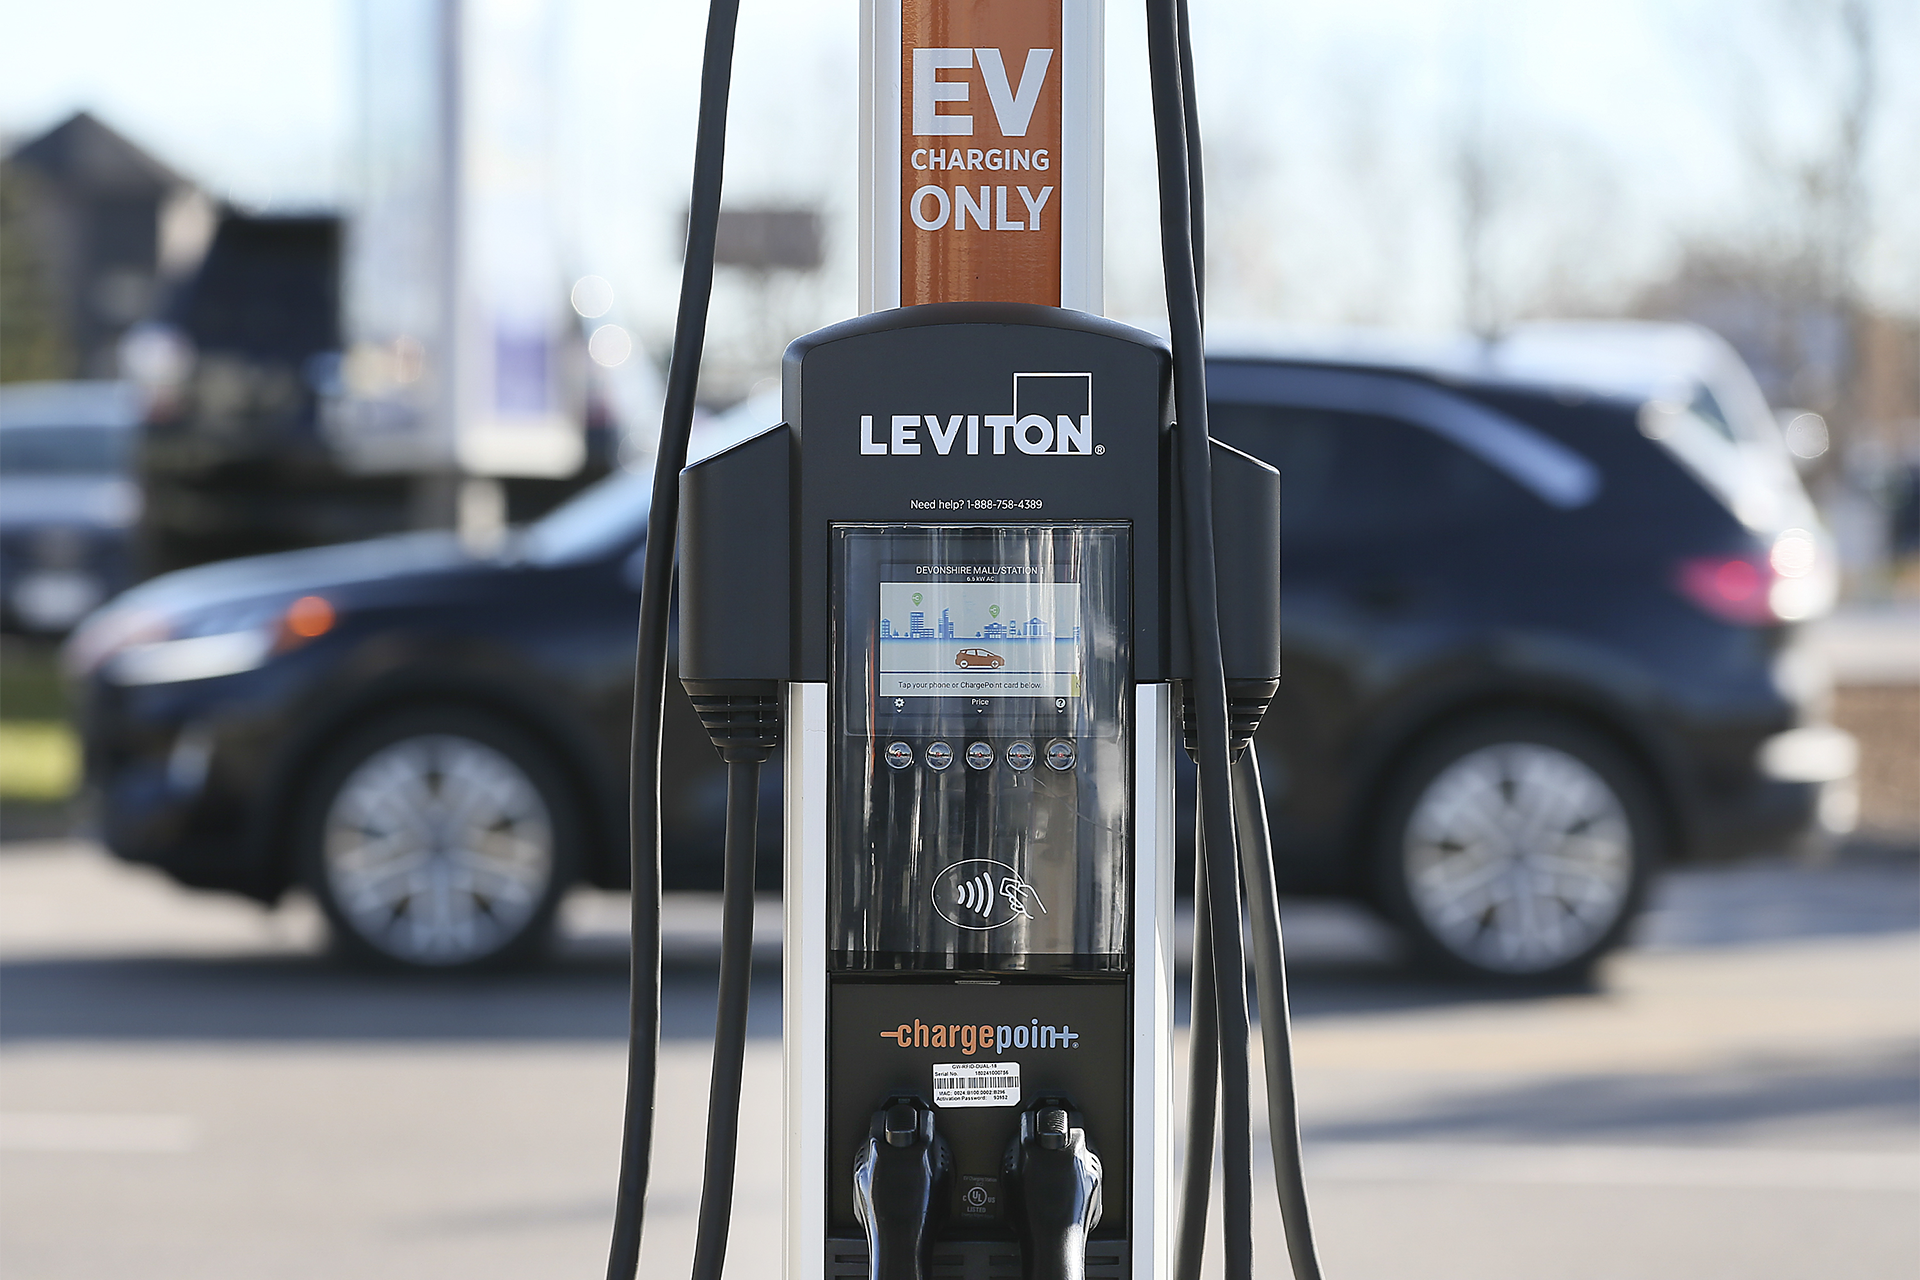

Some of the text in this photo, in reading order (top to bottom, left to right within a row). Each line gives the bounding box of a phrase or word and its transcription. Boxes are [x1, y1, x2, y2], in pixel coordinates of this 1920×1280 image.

[912, 48, 1054, 137] EV
[910, 148, 1050, 171] CHARGING
[910, 184, 1054, 231] ONLY
[860, 414, 1092, 455] LEVITON
[910, 499, 1043, 511] Need help? 1-888-758-4389
[916, 565, 972, 575] DEVONSHIRE
[973, 565, 1038, 575] MALL/STATION
[899, 681, 911, 690] Tap
[929, 681, 951, 690] phone
[960, 681, 1002, 690] ChargePoint
[1003, 681, 1019, 689] card
[971, 698, 990, 706] Price
